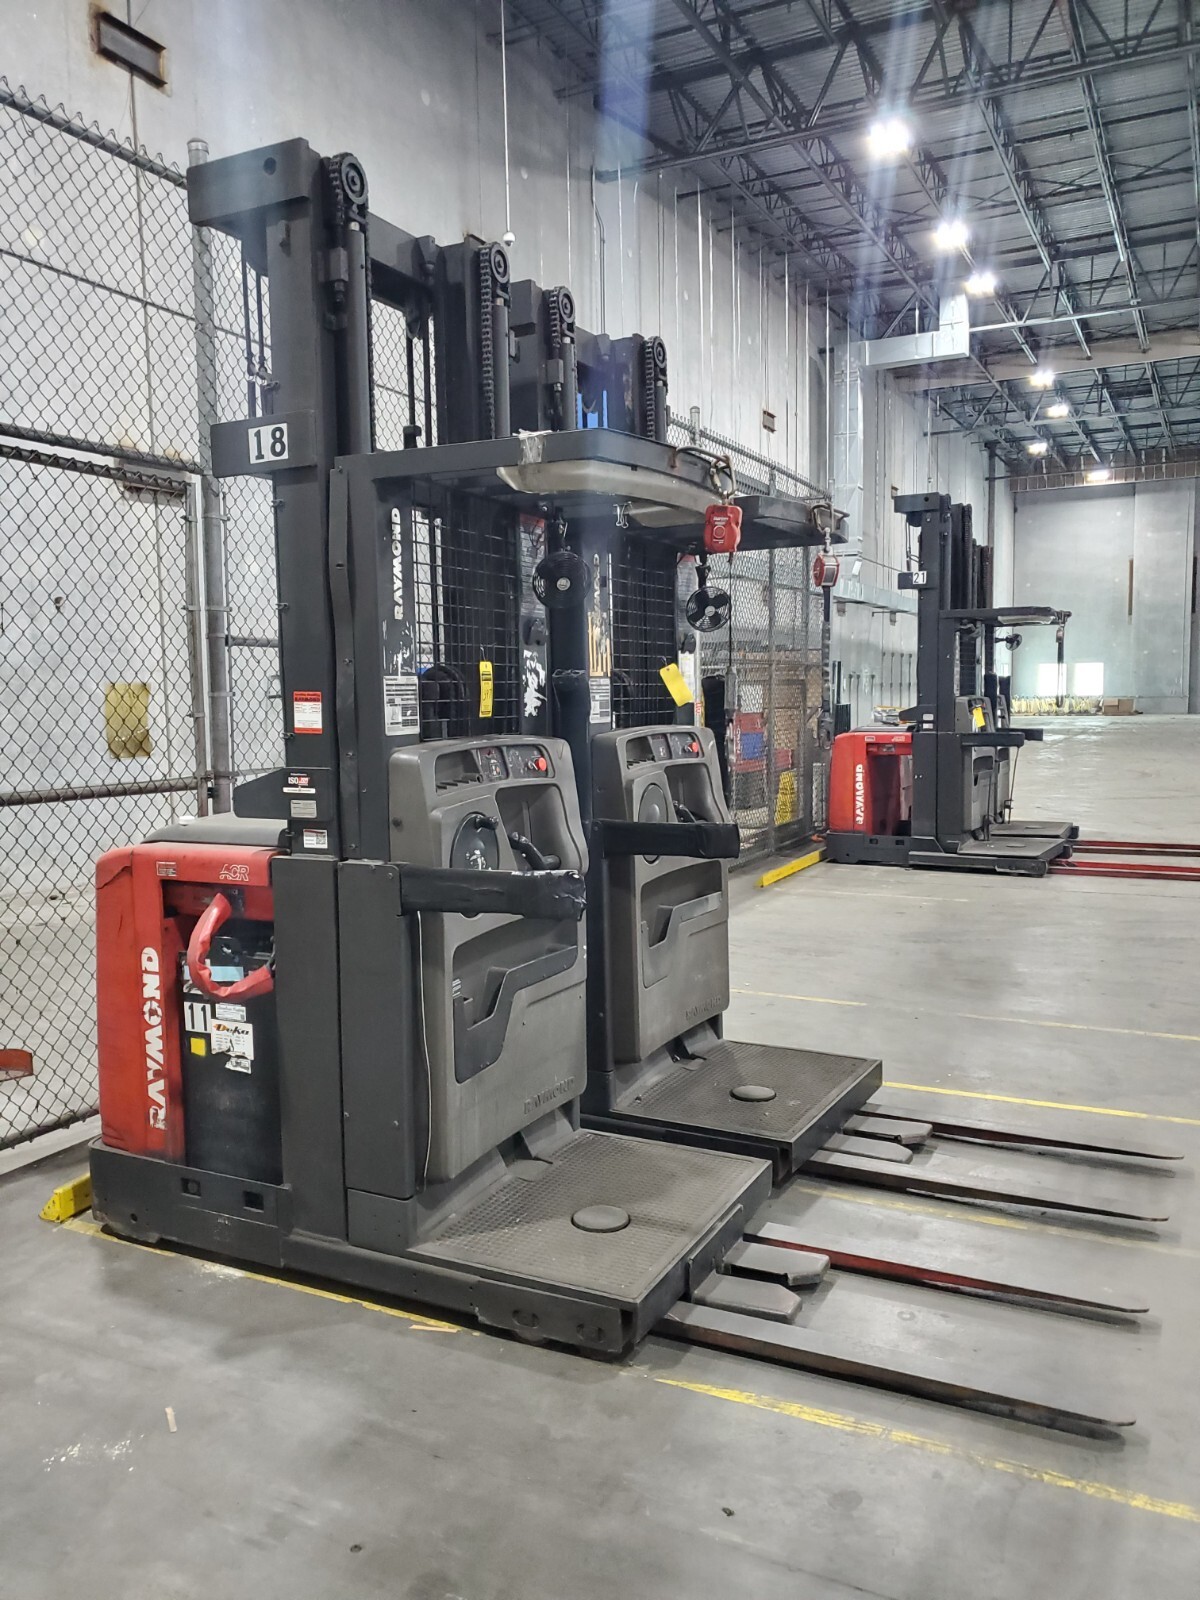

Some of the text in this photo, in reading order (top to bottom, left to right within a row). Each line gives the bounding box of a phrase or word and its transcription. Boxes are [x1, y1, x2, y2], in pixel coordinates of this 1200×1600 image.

[253, 426, 286, 461] 18
[391, 507, 404, 620] RAYMOND
[913, 572, 925, 584] 21
[855, 763, 865, 825] RAYMOND
[141, 946, 167, 1130] RAYMOND
[188, 1003, 208, 1032] 11
